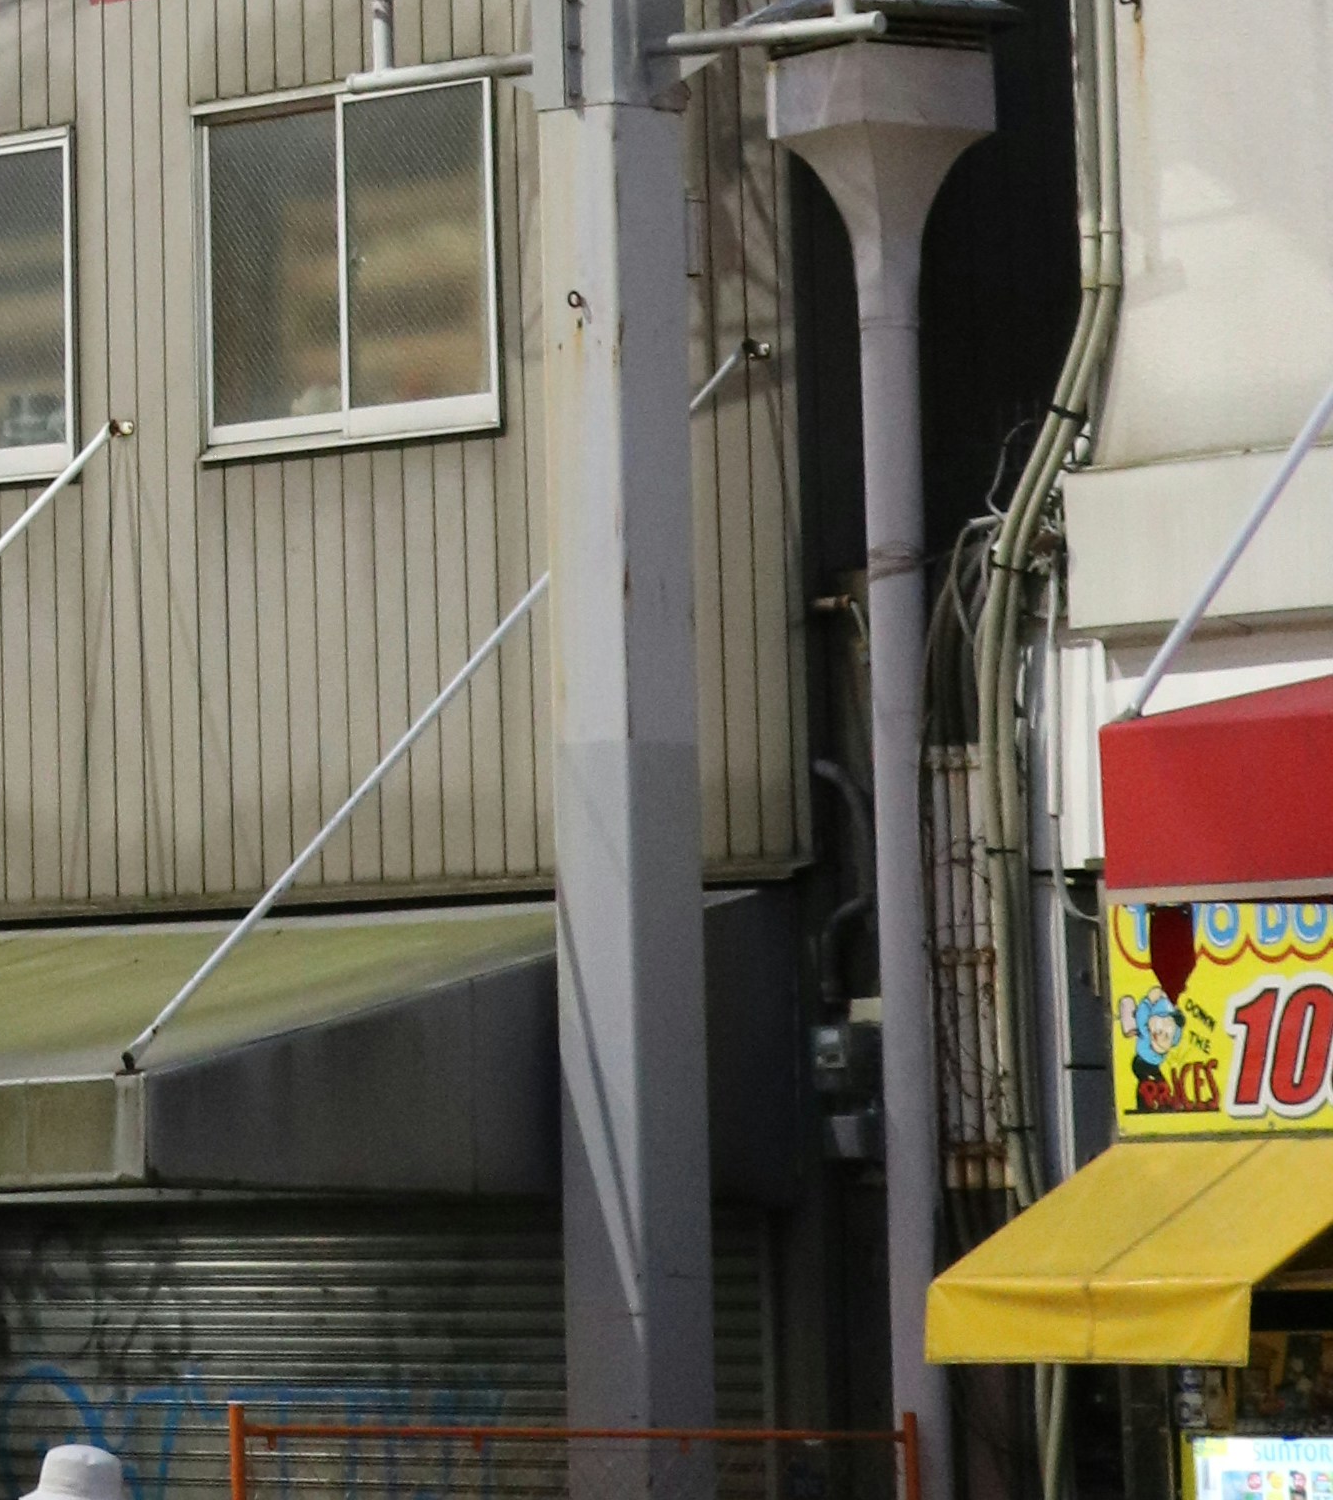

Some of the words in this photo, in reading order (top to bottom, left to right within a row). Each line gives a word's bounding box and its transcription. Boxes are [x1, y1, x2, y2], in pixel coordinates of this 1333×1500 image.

[1187, 1031, 1212, 1054] THE
[1234, 984, 1333, 1105] 10
[1139, 1058, 1219, 1110] PRICES
